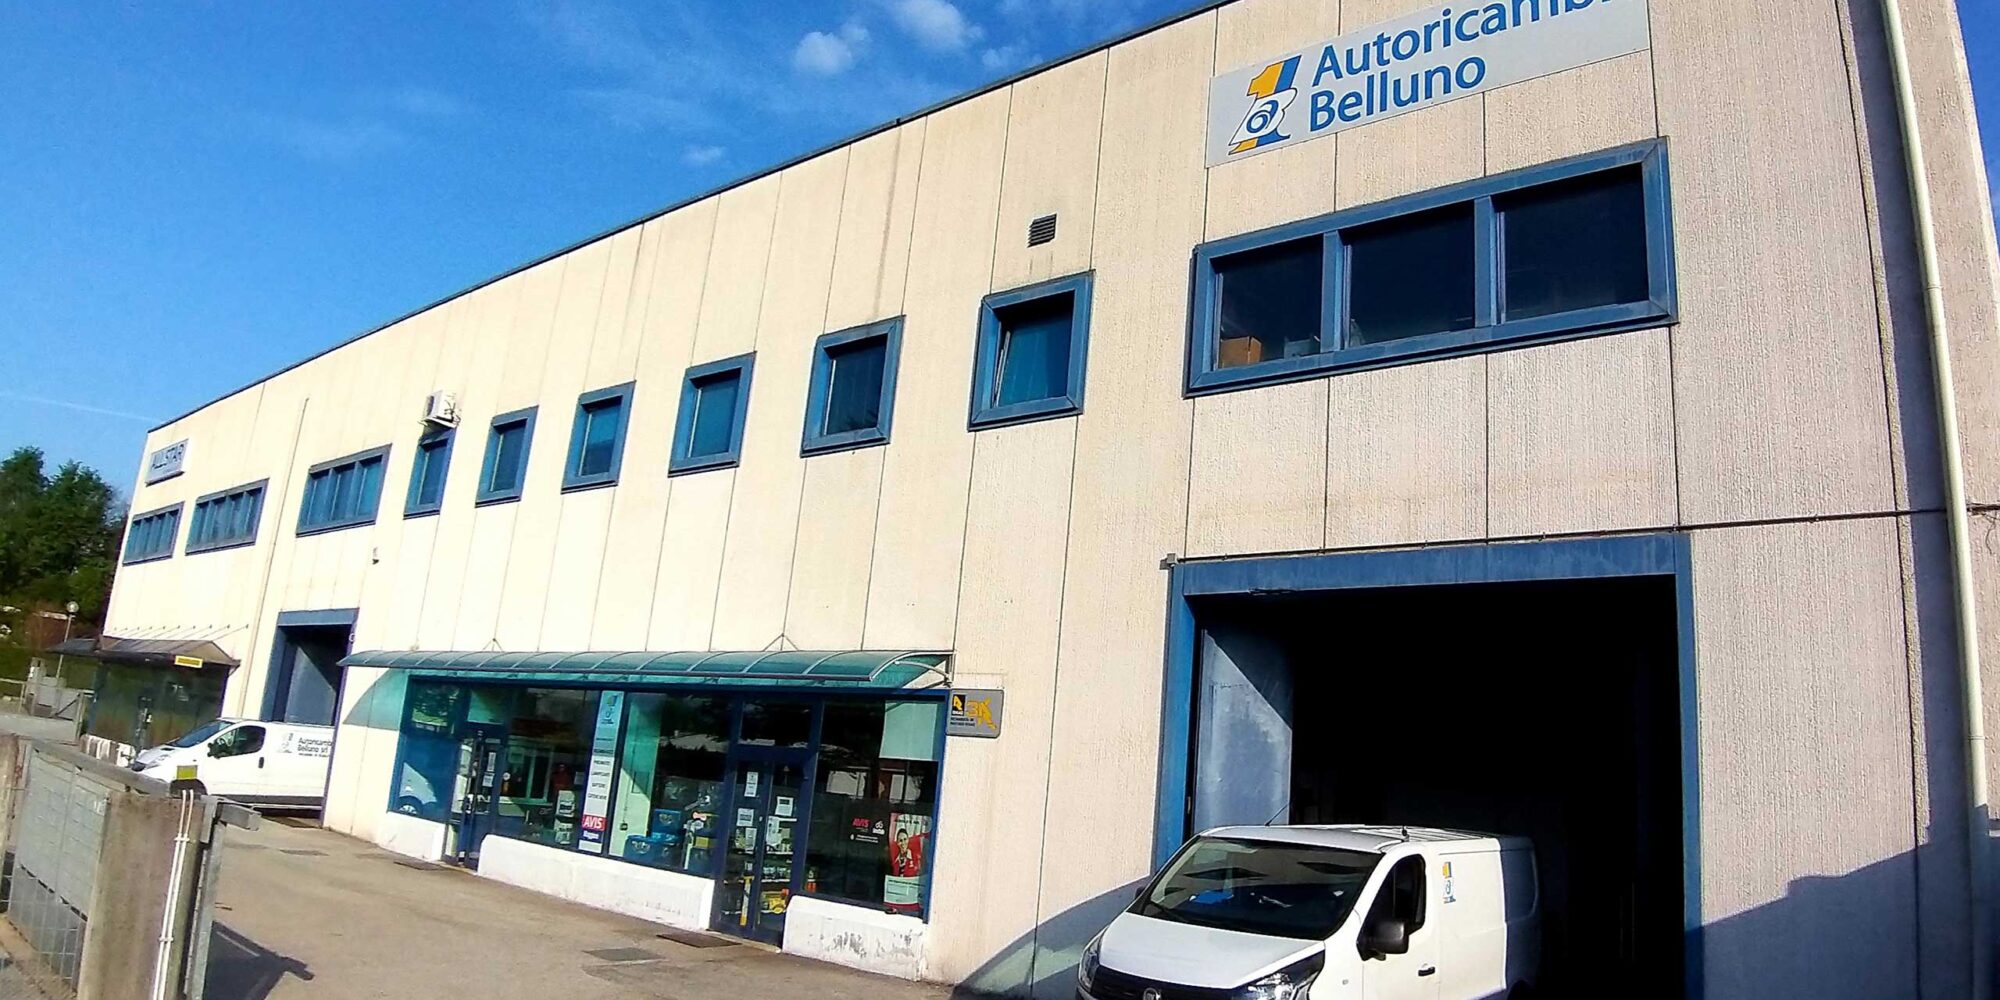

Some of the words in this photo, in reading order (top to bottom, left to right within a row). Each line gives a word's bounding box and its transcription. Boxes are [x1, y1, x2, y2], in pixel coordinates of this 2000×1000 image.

[1312, 0, 1609, 87] Autoricam
[1310, 56, 1486, 132] Belluno
[583, 815, 603, 830] AVIS
